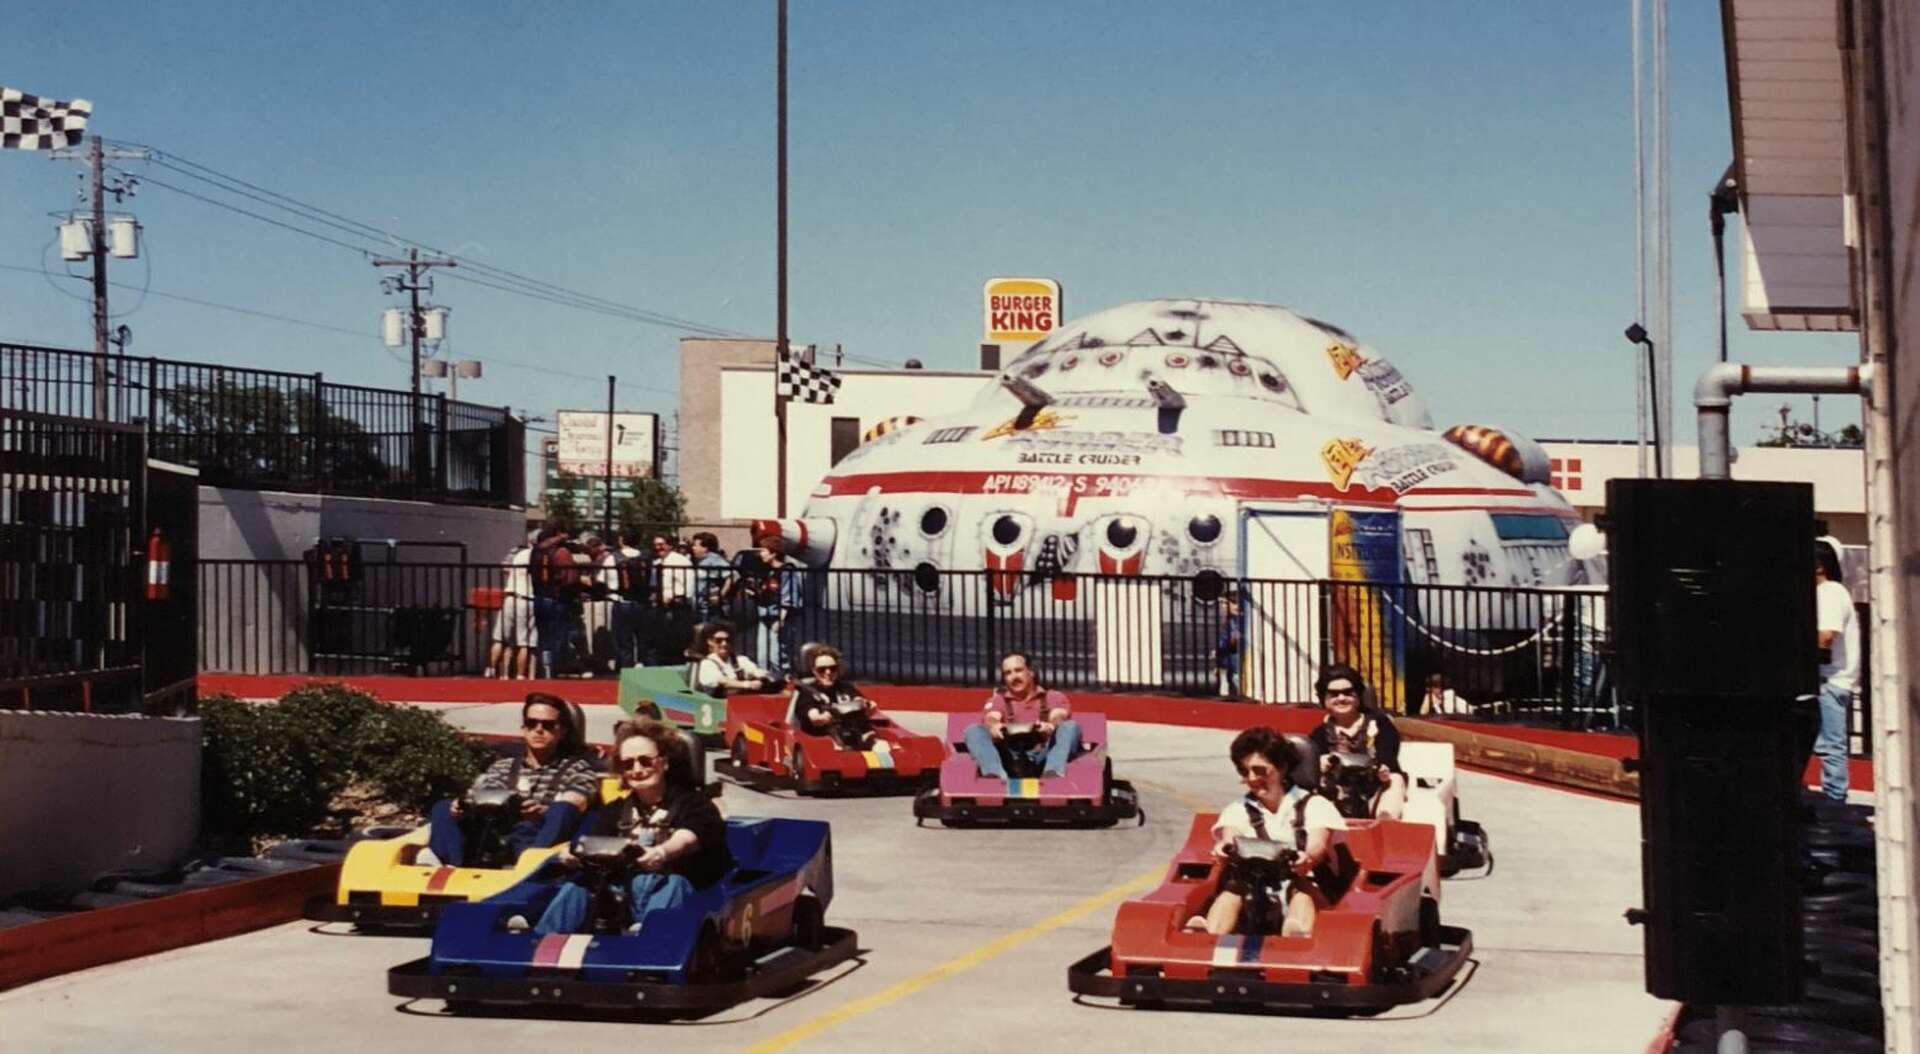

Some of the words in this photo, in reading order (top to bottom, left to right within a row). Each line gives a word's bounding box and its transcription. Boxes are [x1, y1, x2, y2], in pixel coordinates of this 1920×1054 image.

[991, 296, 1052, 311] BURGER
[992, 312, 1052, 331] KING
[1018, 452, 1072, 465] BATTLE
[1078, 453, 1141, 465] CRUISER
